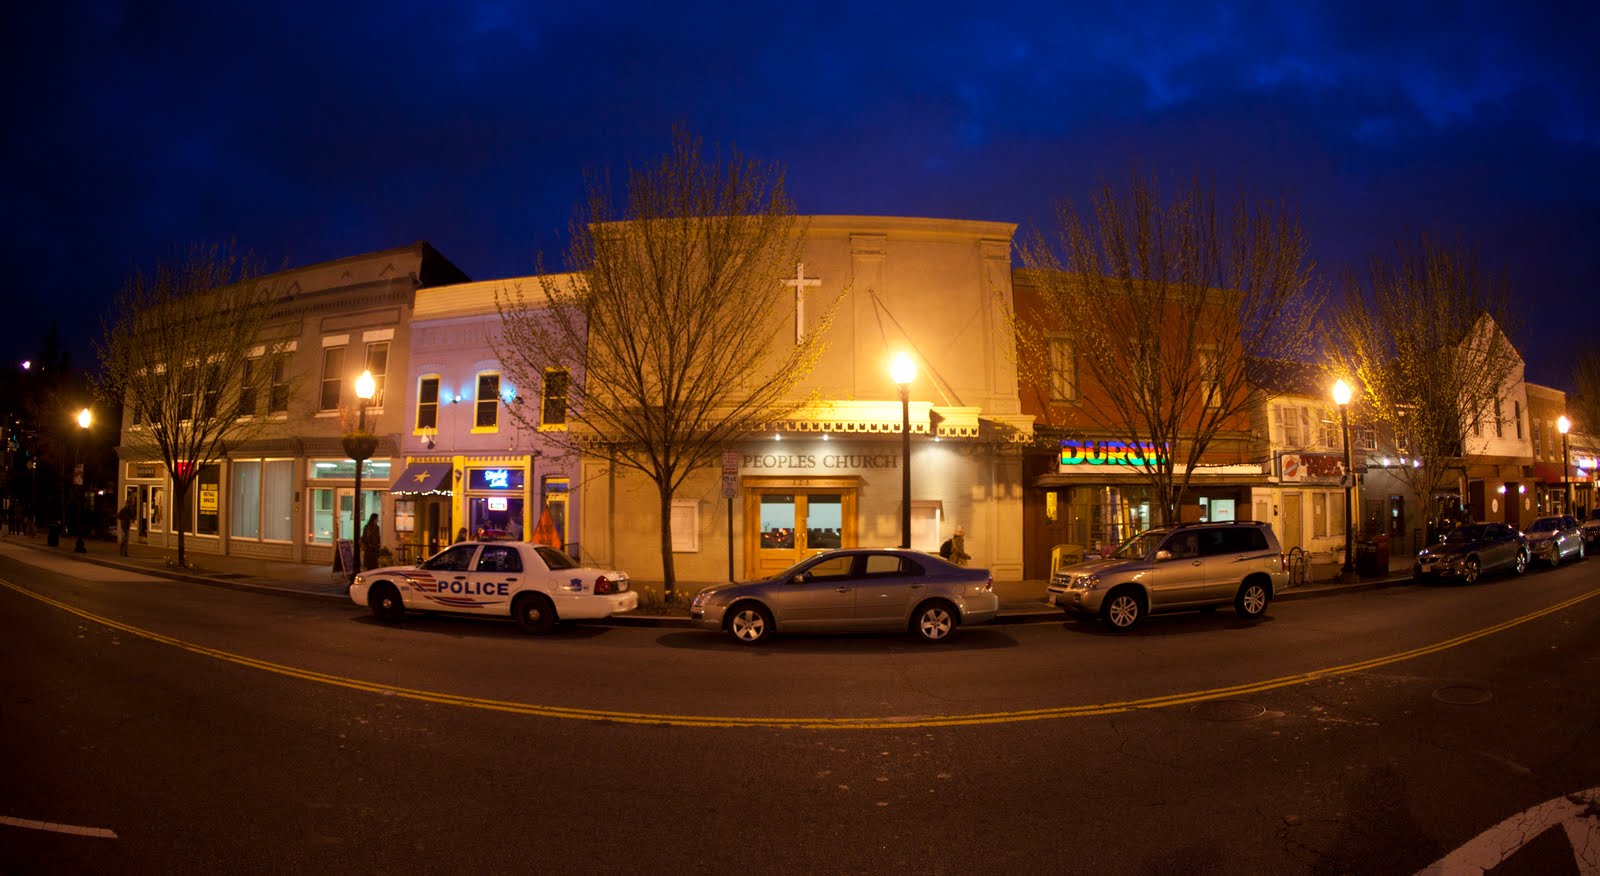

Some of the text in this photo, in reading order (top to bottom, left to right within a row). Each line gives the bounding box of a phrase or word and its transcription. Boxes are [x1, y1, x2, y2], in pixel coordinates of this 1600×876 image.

[742, 454, 816, 469] PEOPLES
[822, 454, 898, 469] CHURCH
[437, 581, 509, 596] POLICE
